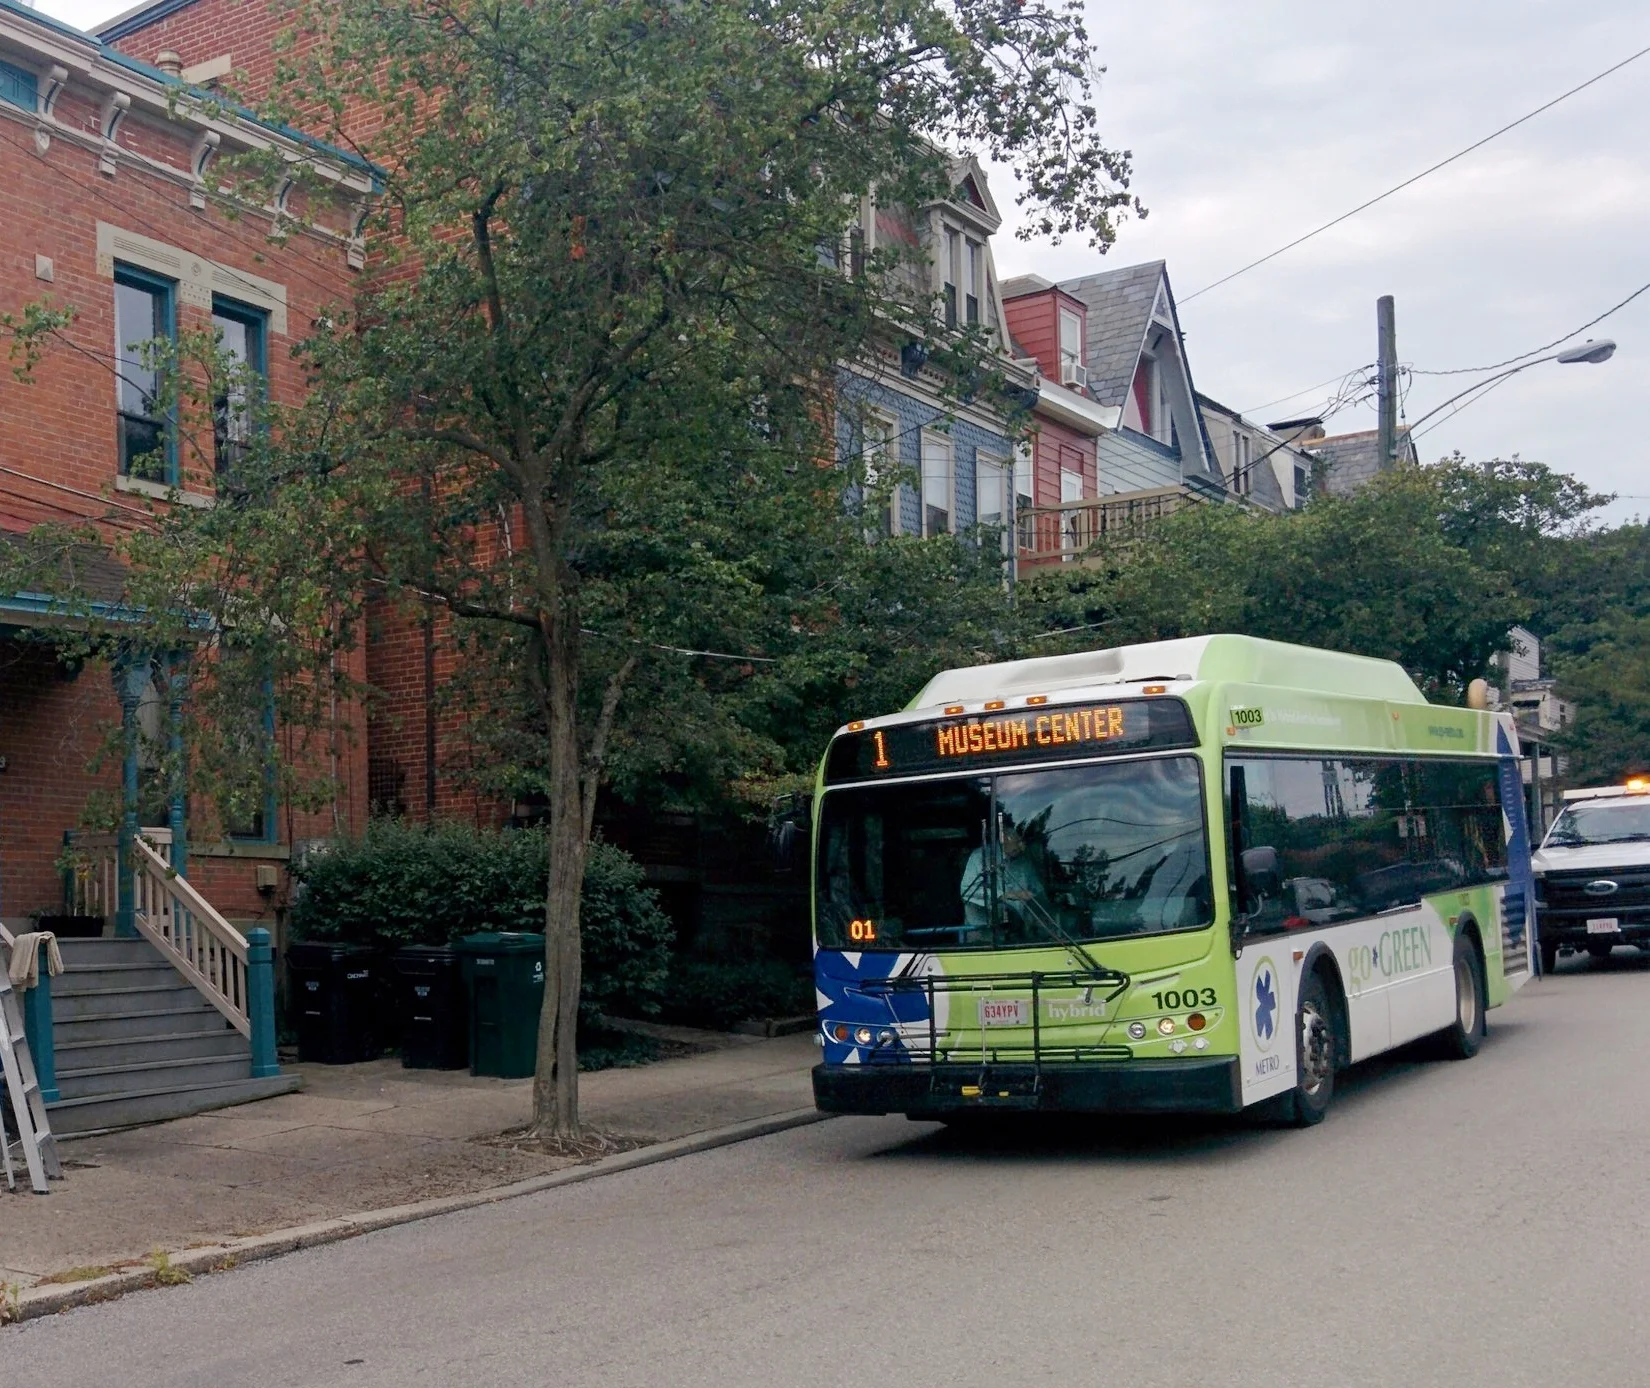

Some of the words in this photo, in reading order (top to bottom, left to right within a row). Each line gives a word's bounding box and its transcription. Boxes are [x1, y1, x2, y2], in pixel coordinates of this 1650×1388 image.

[1235, 709, 1262, 723] 1003
[873, 731, 889, 767] 1
[937, 718, 1029, 756] MUSEUM
[1035, 707, 1124, 745] CENTER
[851, 919, 875, 940] 01
[1379, 925, 1432, 977] GREEN
[1151, 987, 1217, 1010] 1003
[1048, 1002, 1106, 1022] hybrid
[1255, 1054, 1280, 1077] METRO
